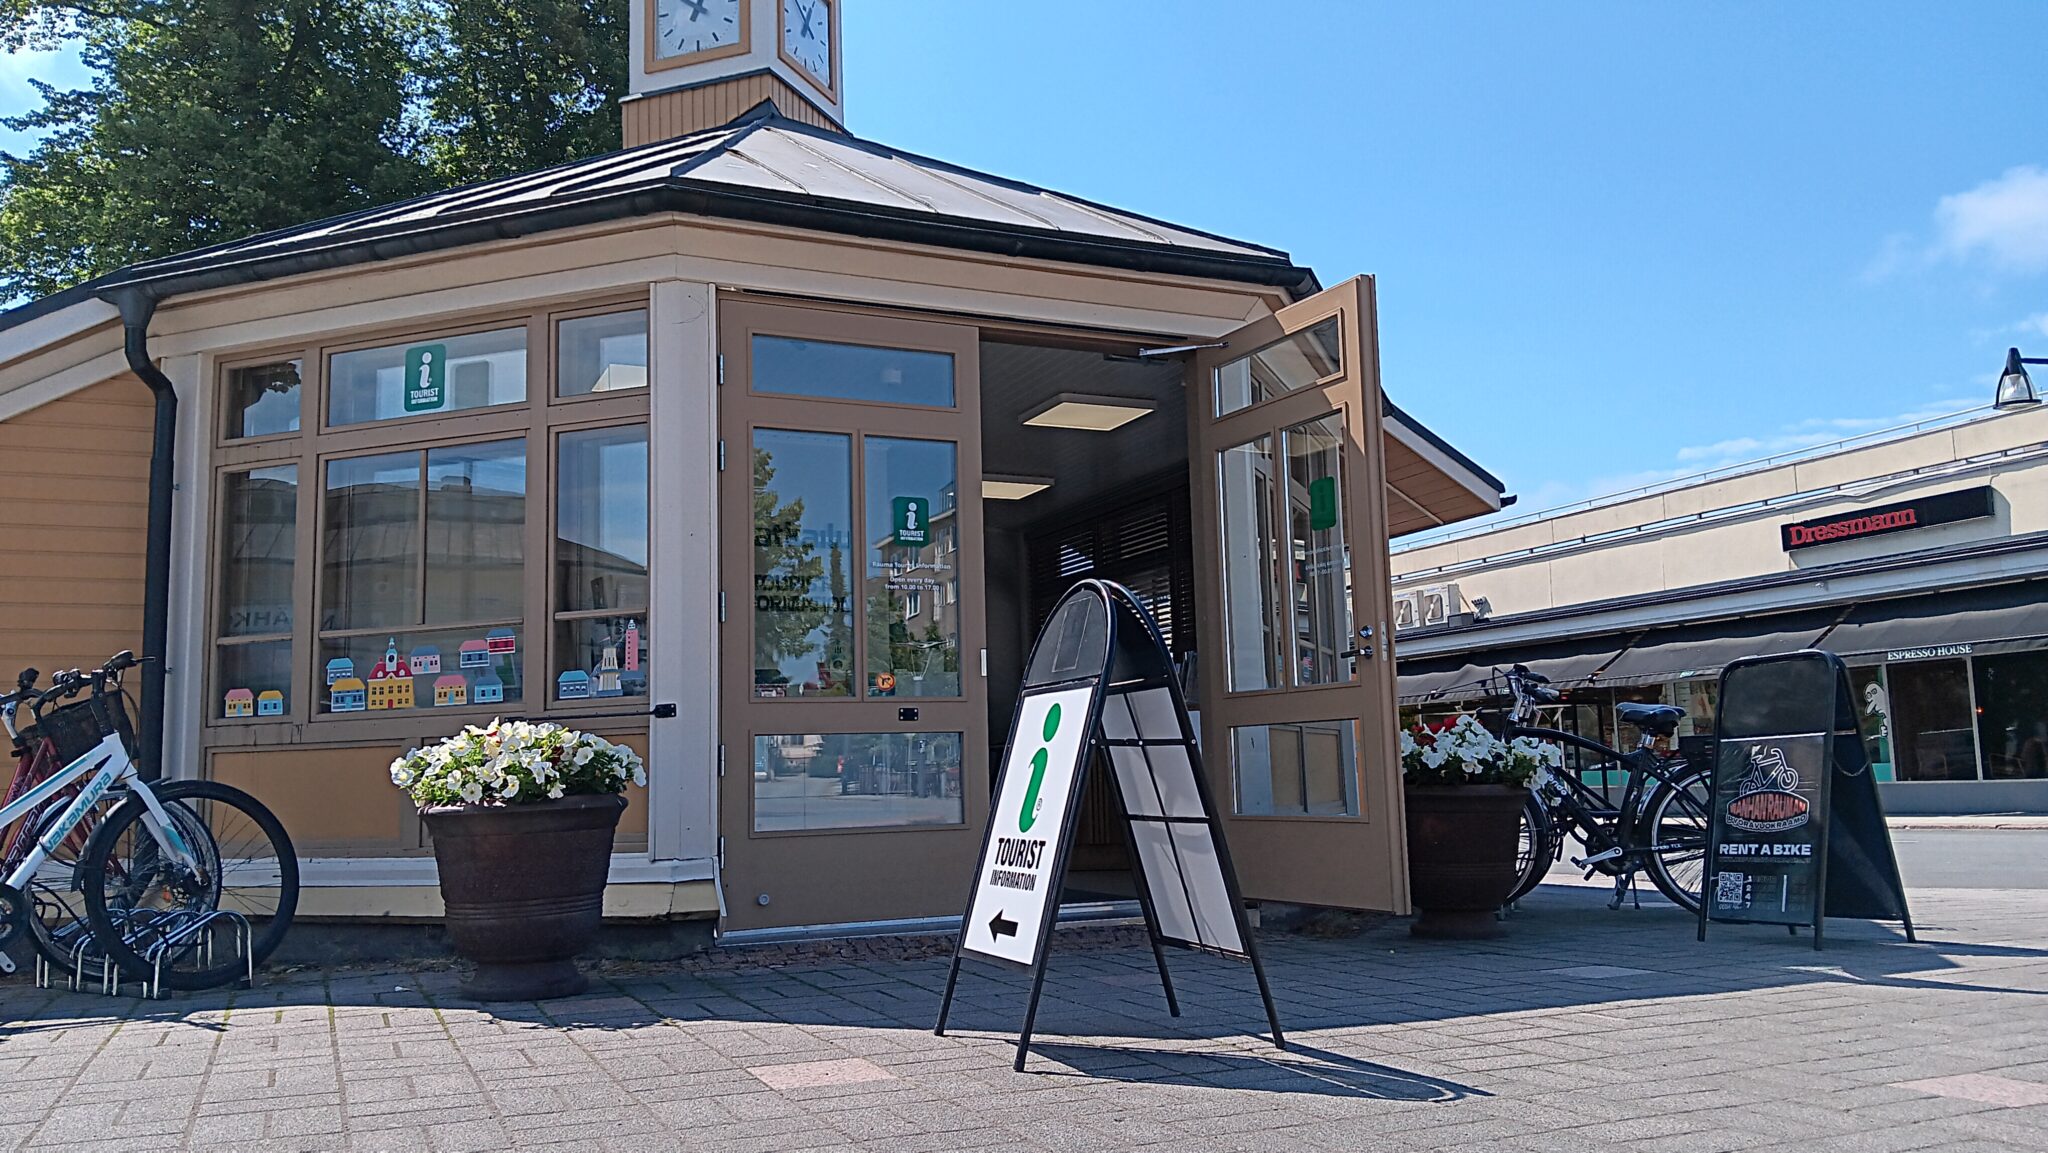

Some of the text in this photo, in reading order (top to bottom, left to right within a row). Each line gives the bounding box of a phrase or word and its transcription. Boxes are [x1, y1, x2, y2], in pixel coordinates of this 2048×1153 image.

[410, 388, 439, 399] TOURIST
[899, 529, 924, 538] TOURIST
[1789, 508, 1917, 546] Dressmann
[924, 577, 935, 585] day
[1887, 644, 1973, 661] ESPRESSO HOUSE
[994, 837, 1046, 870] TOURIST
[1720, 844, 1811, 856] RENT A BIKE
[990, 869, 1037, 891] INFORMATION
